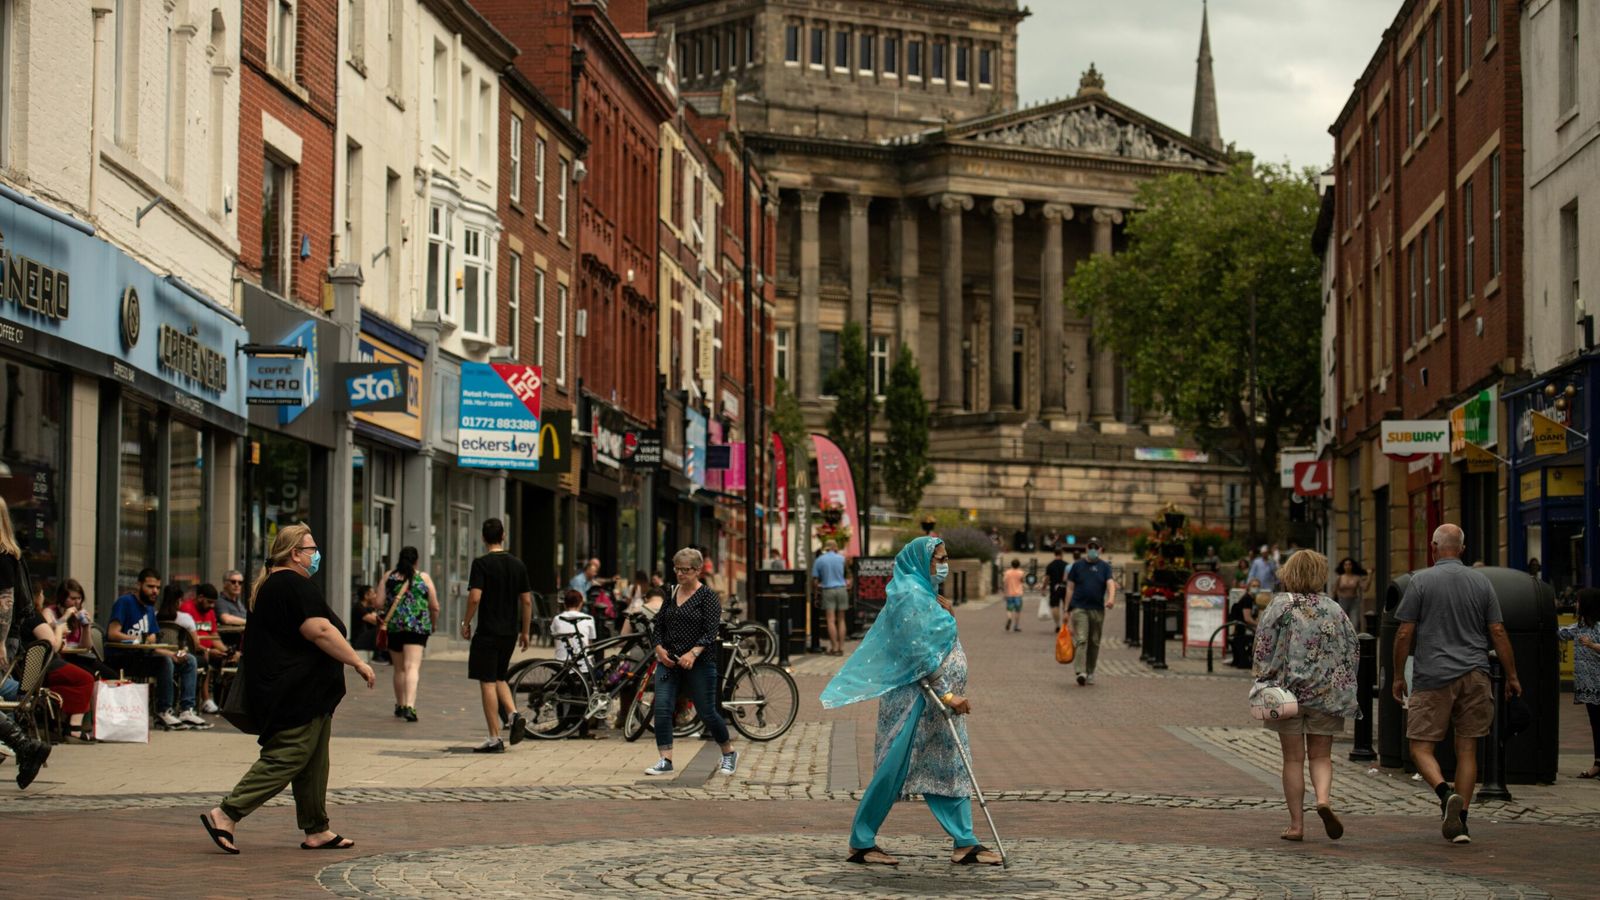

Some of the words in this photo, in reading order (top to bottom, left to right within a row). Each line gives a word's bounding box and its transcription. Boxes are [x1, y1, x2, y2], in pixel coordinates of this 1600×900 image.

[521, 366, 541, 390] TO
[248, 379, 300, 390] NERO
[351, 374, 394, 401] sta
[507, 373, 535, 402] LET
[462, 416, 495, 428] 01772
[1387, 431, 1445, 443] SUBWAY
[1535, 432, 1565, 442] LOANS
[461, 434, 536, 458] eckersley
[640, 446, 660, 454] VAPE
[634, 454, 661, 463] STORE
